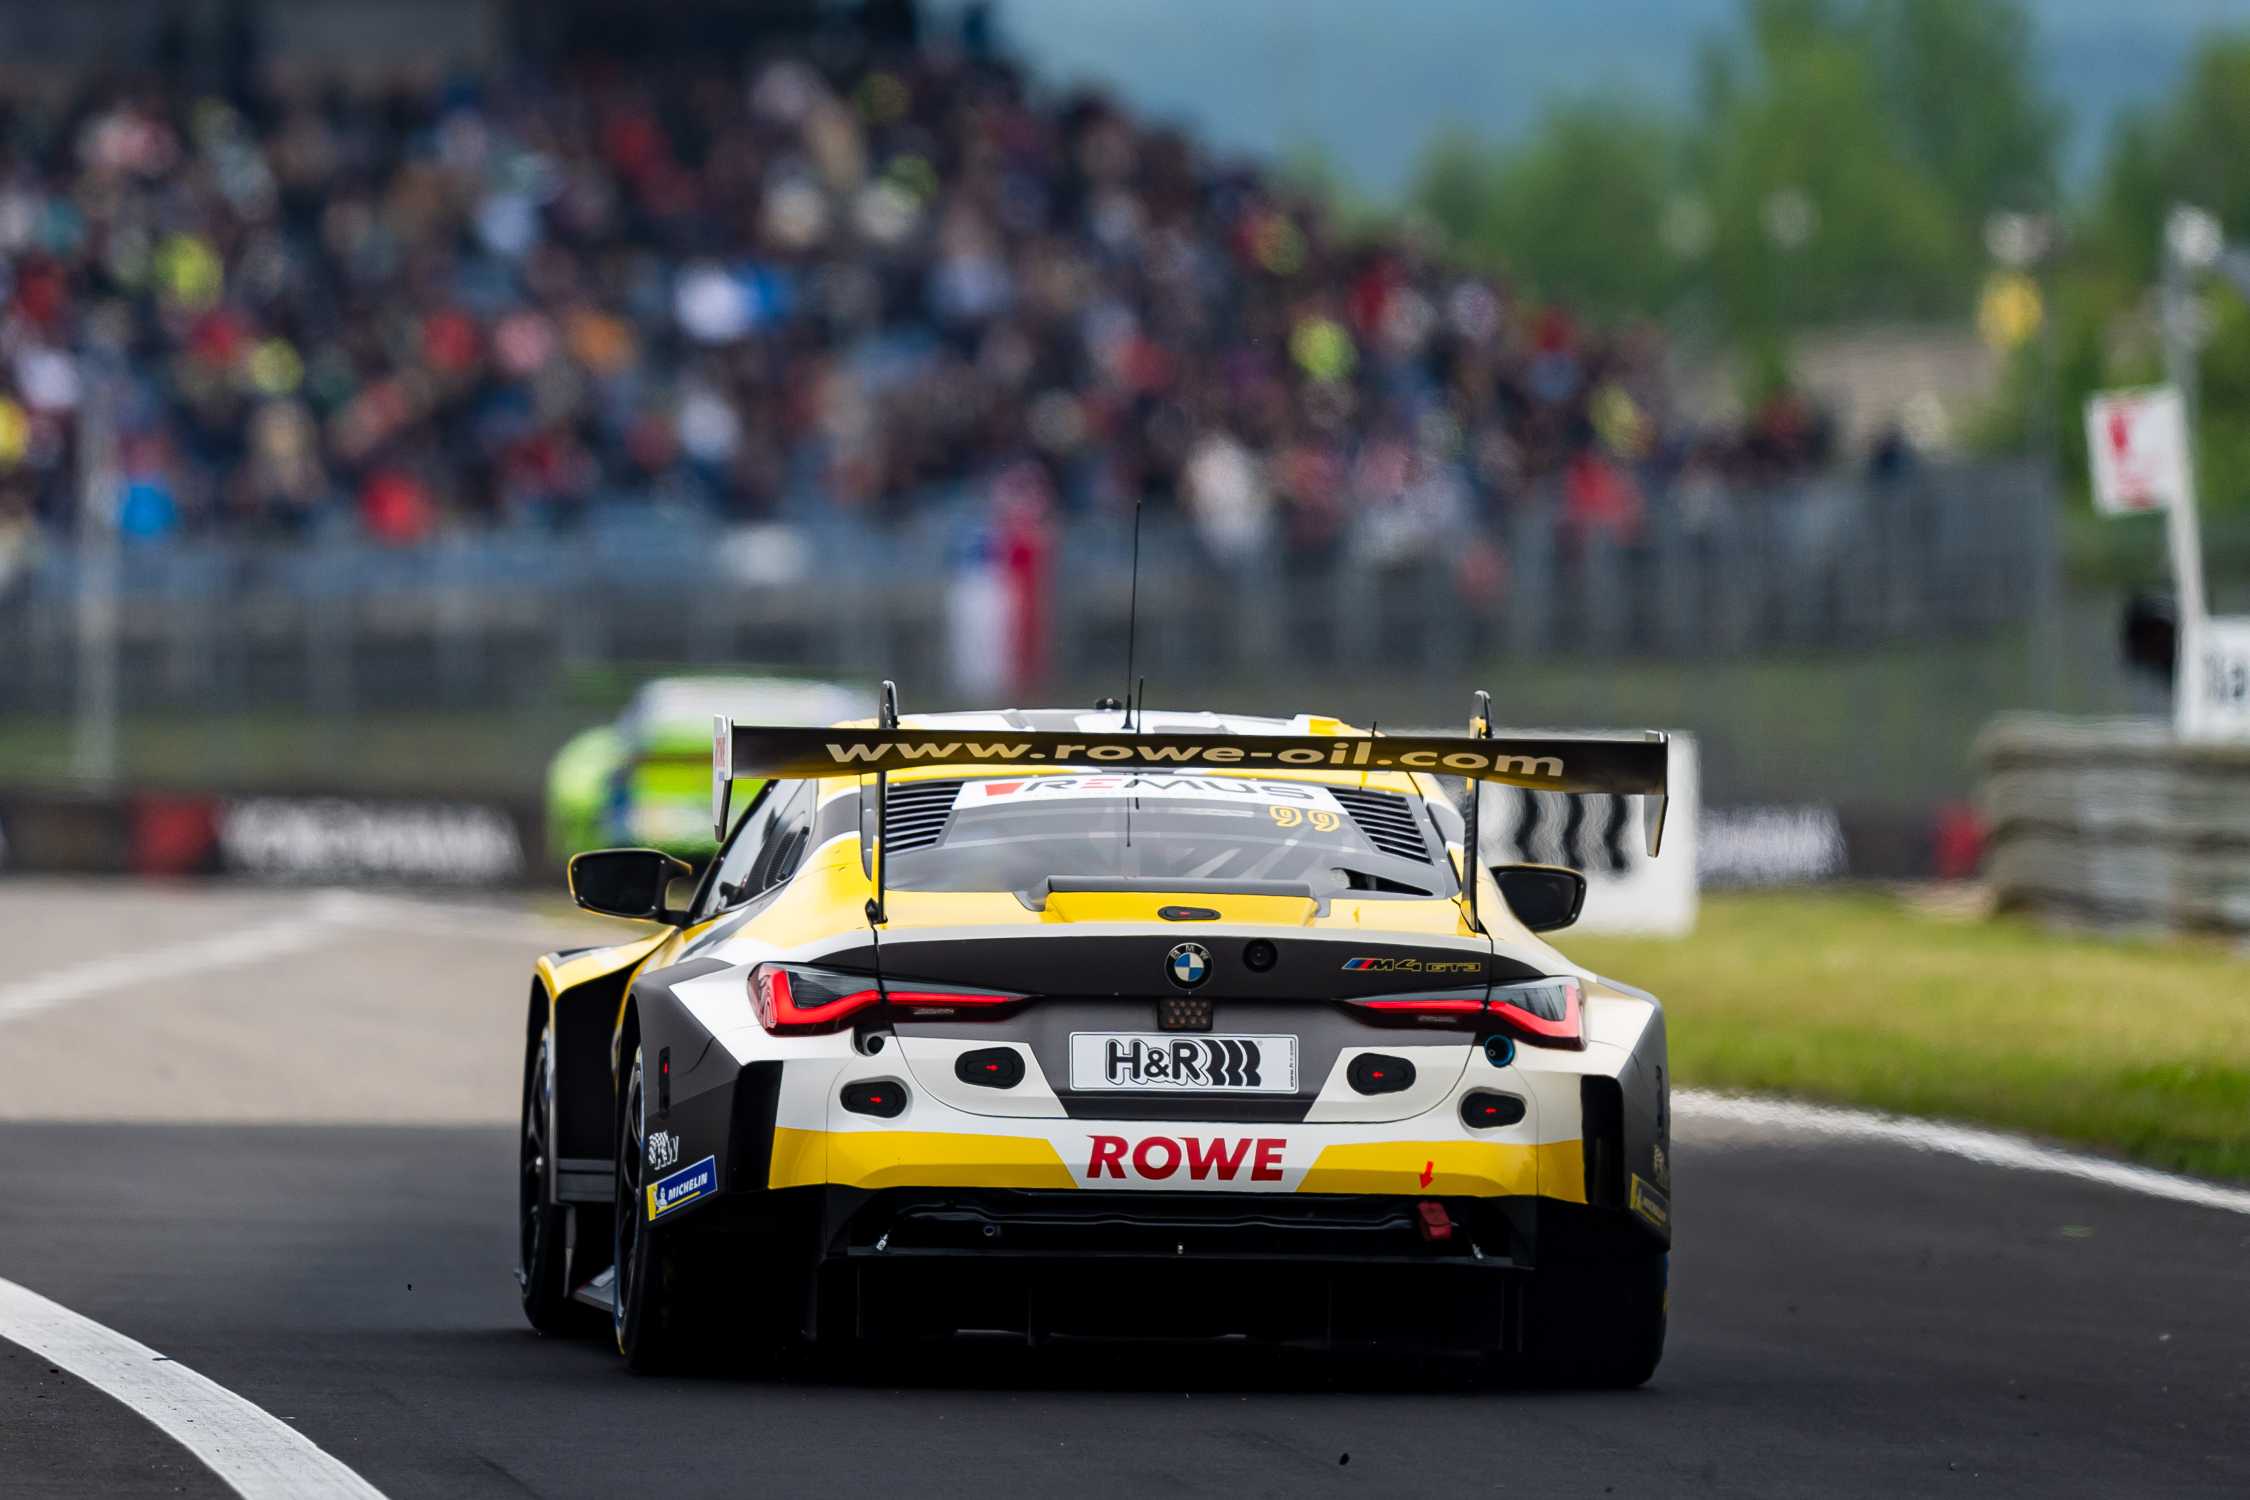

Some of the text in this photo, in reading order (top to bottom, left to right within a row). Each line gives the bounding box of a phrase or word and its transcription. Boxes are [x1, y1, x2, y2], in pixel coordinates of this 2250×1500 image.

[825, 741, 1565, 778] www.rowe-oil.com
[1024, 777, 1315, 800] REMUS
[1268, 804, 1341, 833] 99
[1364, 957, 1481, 973] M4 GT3
[1106, 1039, 1203, 1082] H&R
[1086, 1134, 1287, 1182] ROWE
[668, 1171, 708, 1201] MICHELIN
